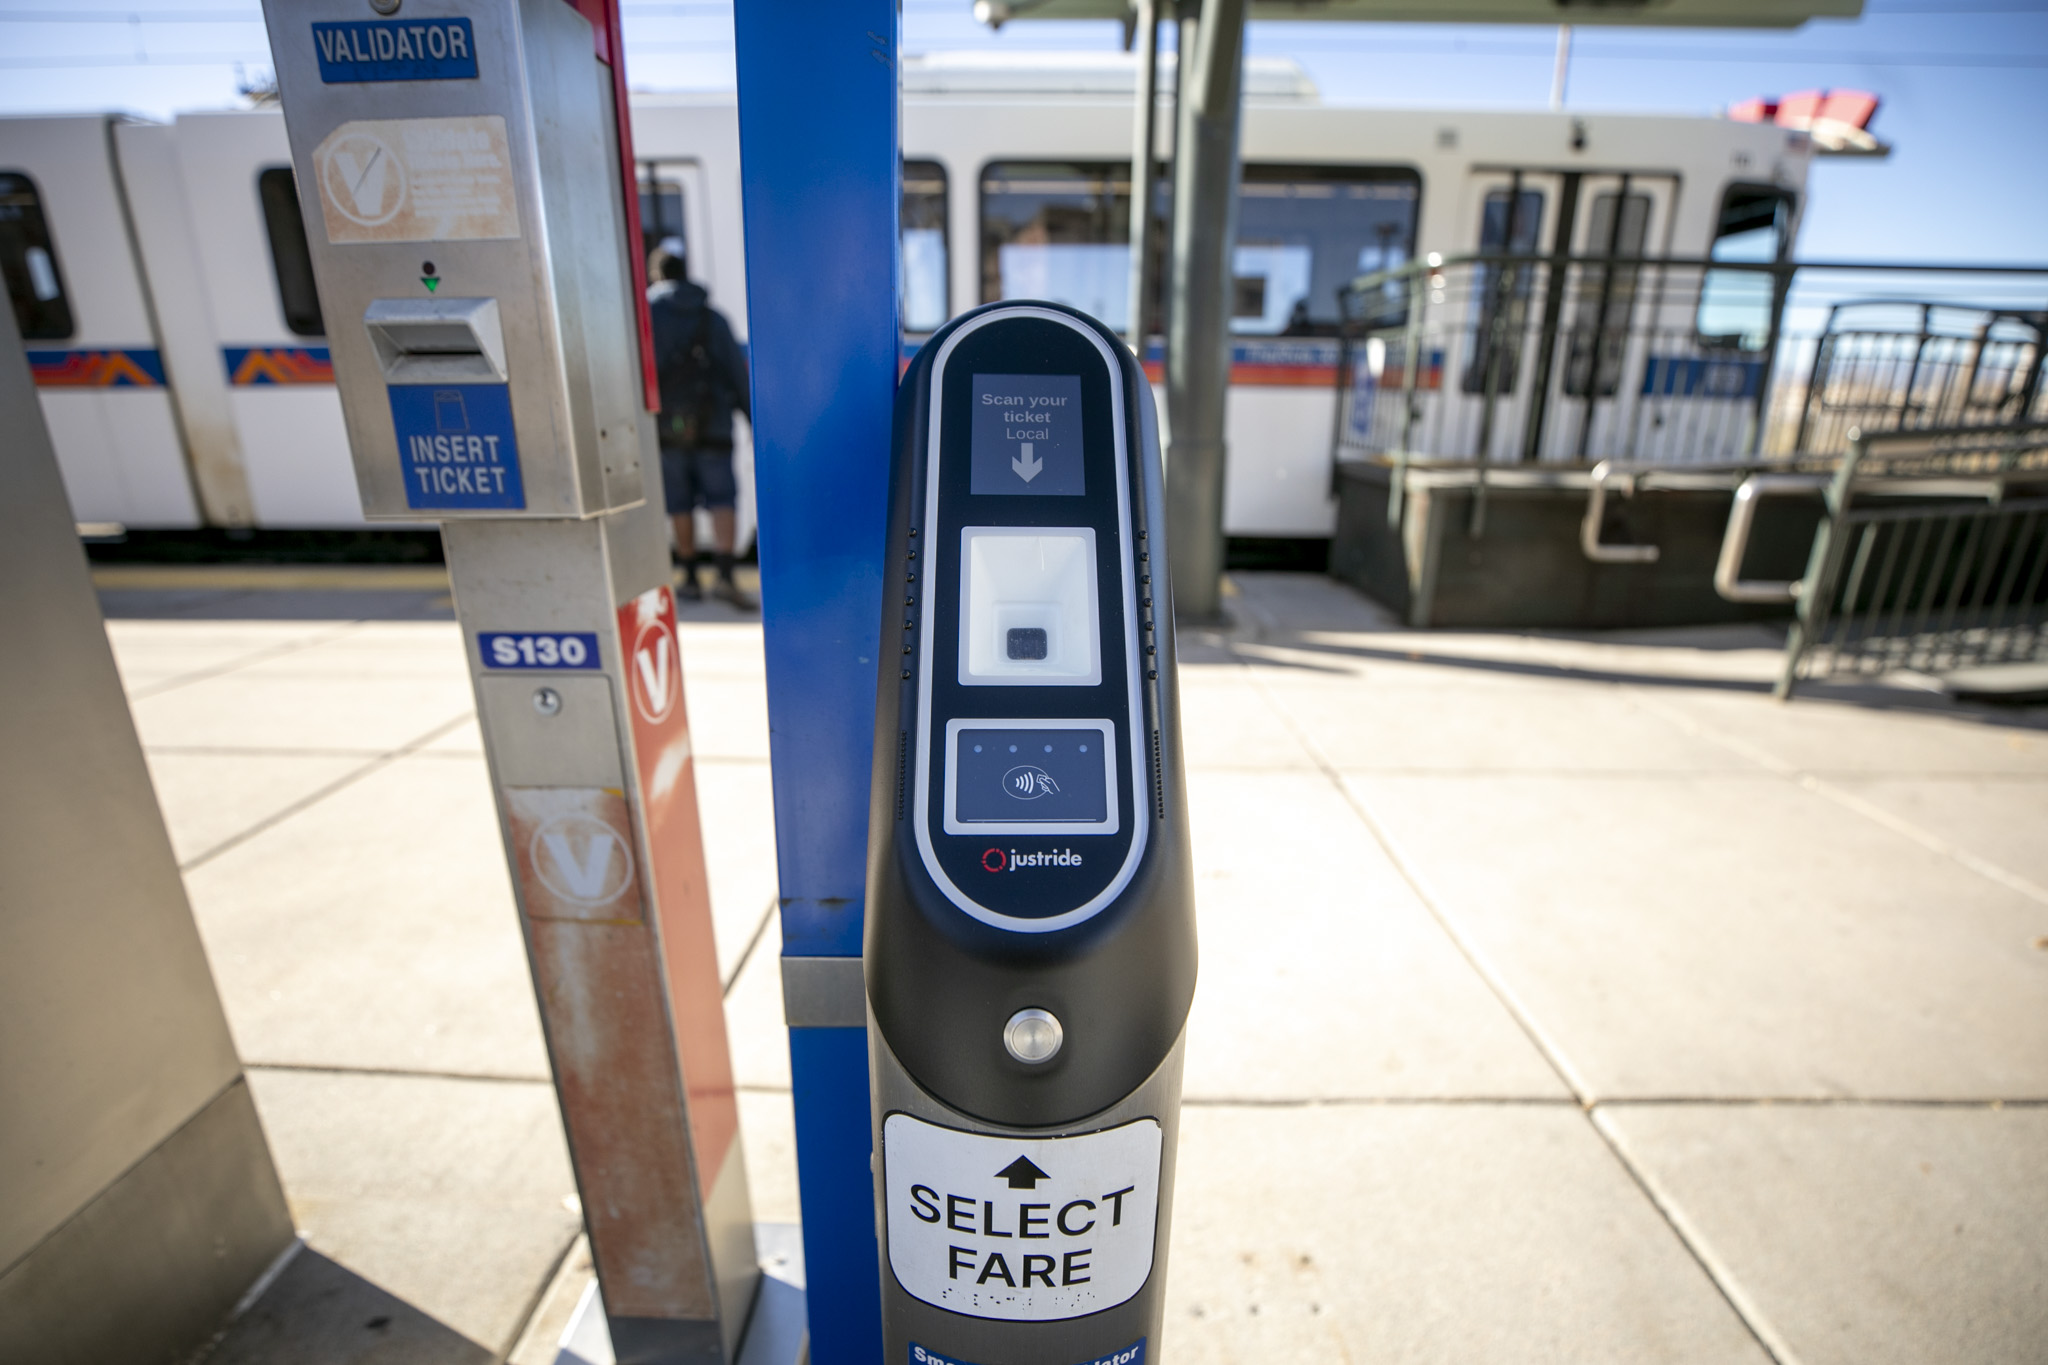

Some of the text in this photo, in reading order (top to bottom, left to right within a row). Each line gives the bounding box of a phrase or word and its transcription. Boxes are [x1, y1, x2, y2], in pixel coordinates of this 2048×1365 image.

[316, 25, 468, 63] VALIDATOR
[981, 393, 1068, 409] Scan your
[1003, 410, 1051, 423] ticket
[1006, 427, 1049, 440] Local
[408, 435, 500, 463] INSERT
[414, 467, 506, 494] TICKET
[491, 636, 587, 666] S130
[1008, 848, 1083, 872] justride
[910, 1184, 1135, 1239] SELECT
[948, 1244, 1093, 1289] FARE
